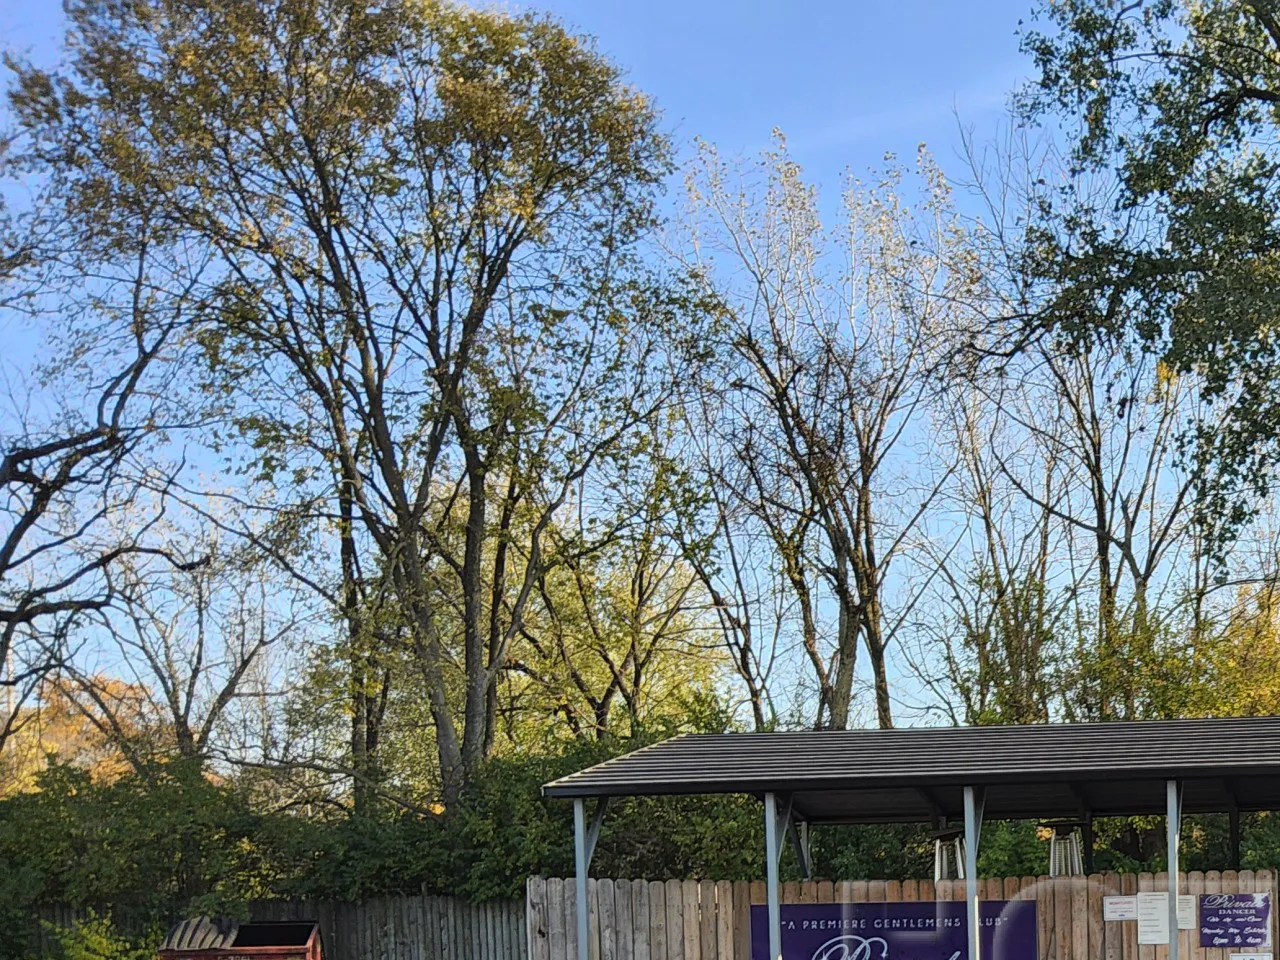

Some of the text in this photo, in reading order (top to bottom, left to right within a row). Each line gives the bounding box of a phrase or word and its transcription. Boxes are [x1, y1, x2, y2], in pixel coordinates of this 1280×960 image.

[781, 920, 796, 930] "A
[802, 919, 866, 930] PREMIERE
[874, 918, 961, 929] GENTLEMENS
